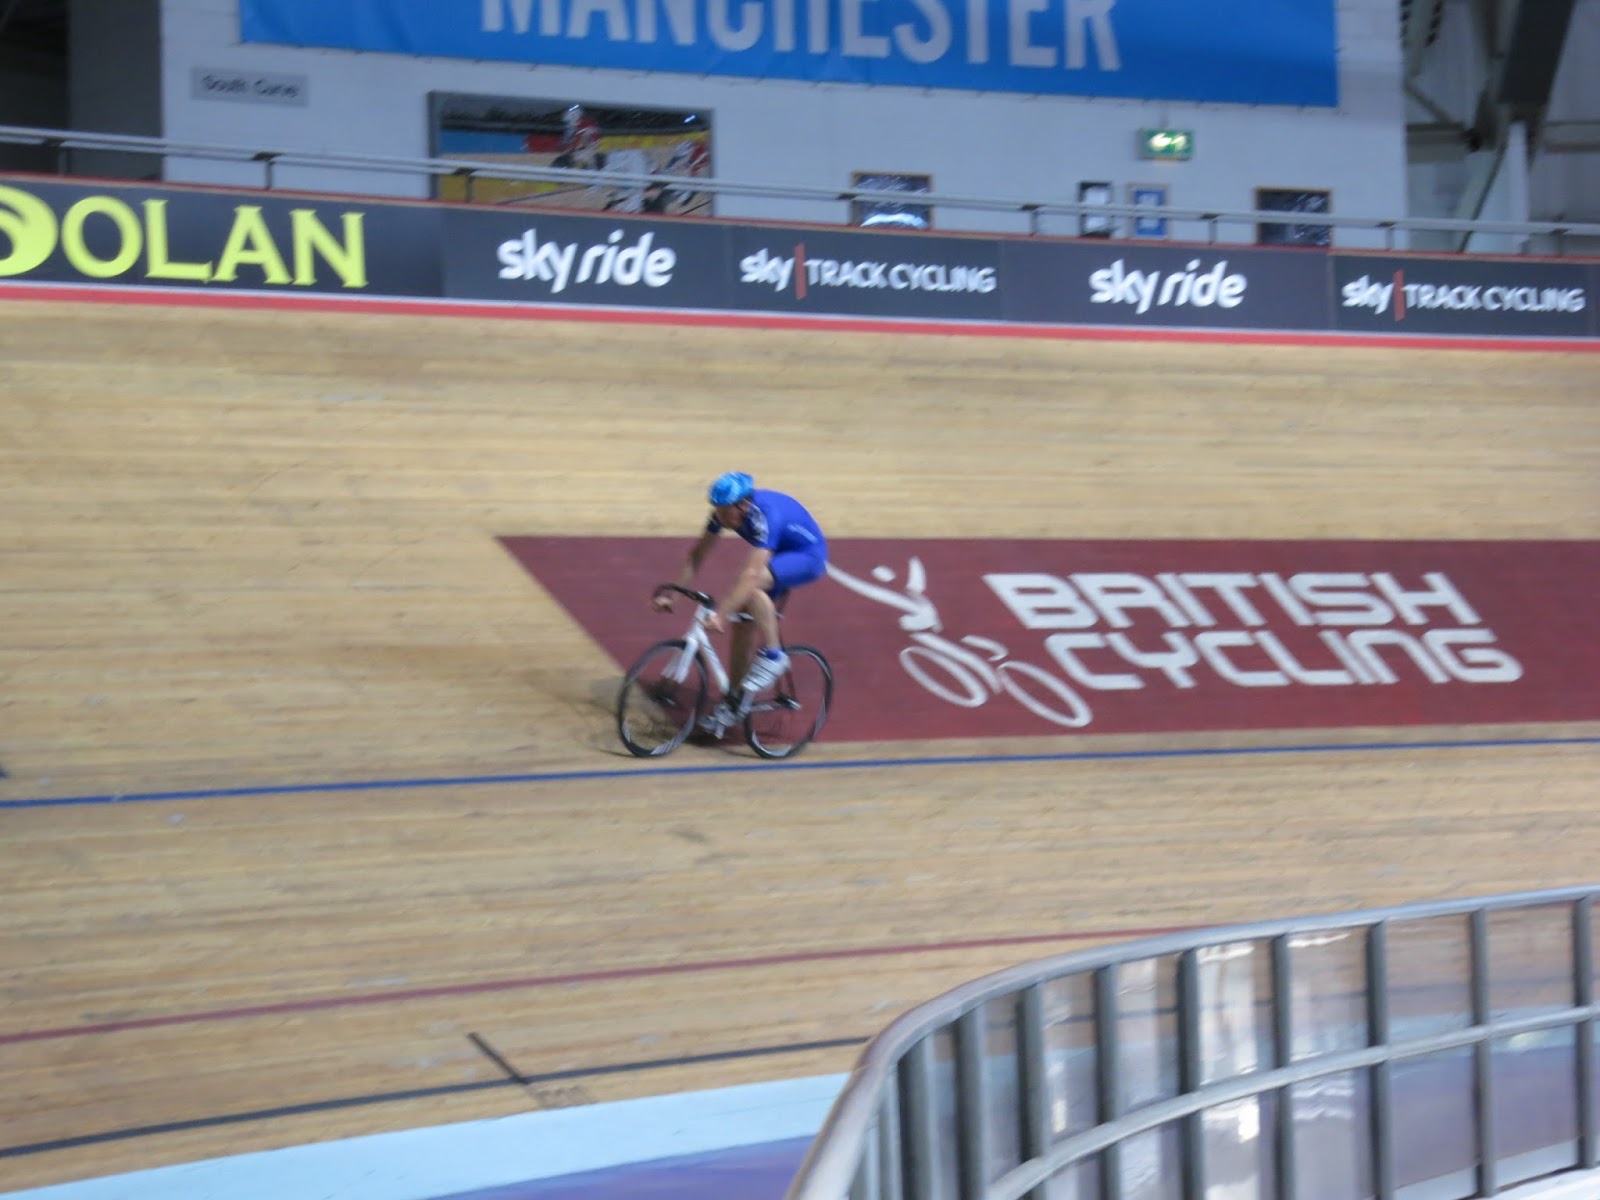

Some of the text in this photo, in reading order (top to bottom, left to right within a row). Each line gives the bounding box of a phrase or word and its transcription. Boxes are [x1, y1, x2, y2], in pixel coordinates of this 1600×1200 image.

[497, 228, 676, 293] sky ride
[739, 248, 996, 293] sky TRACK CYCLING
[1088, 258, 1247, 314] sky ride
[1341, 275, 1586, 315] sky TRACK CYCLING
[982, 572, 1481, 629] BRITISH
[1045, 628, 1523, 690] CYCLING
